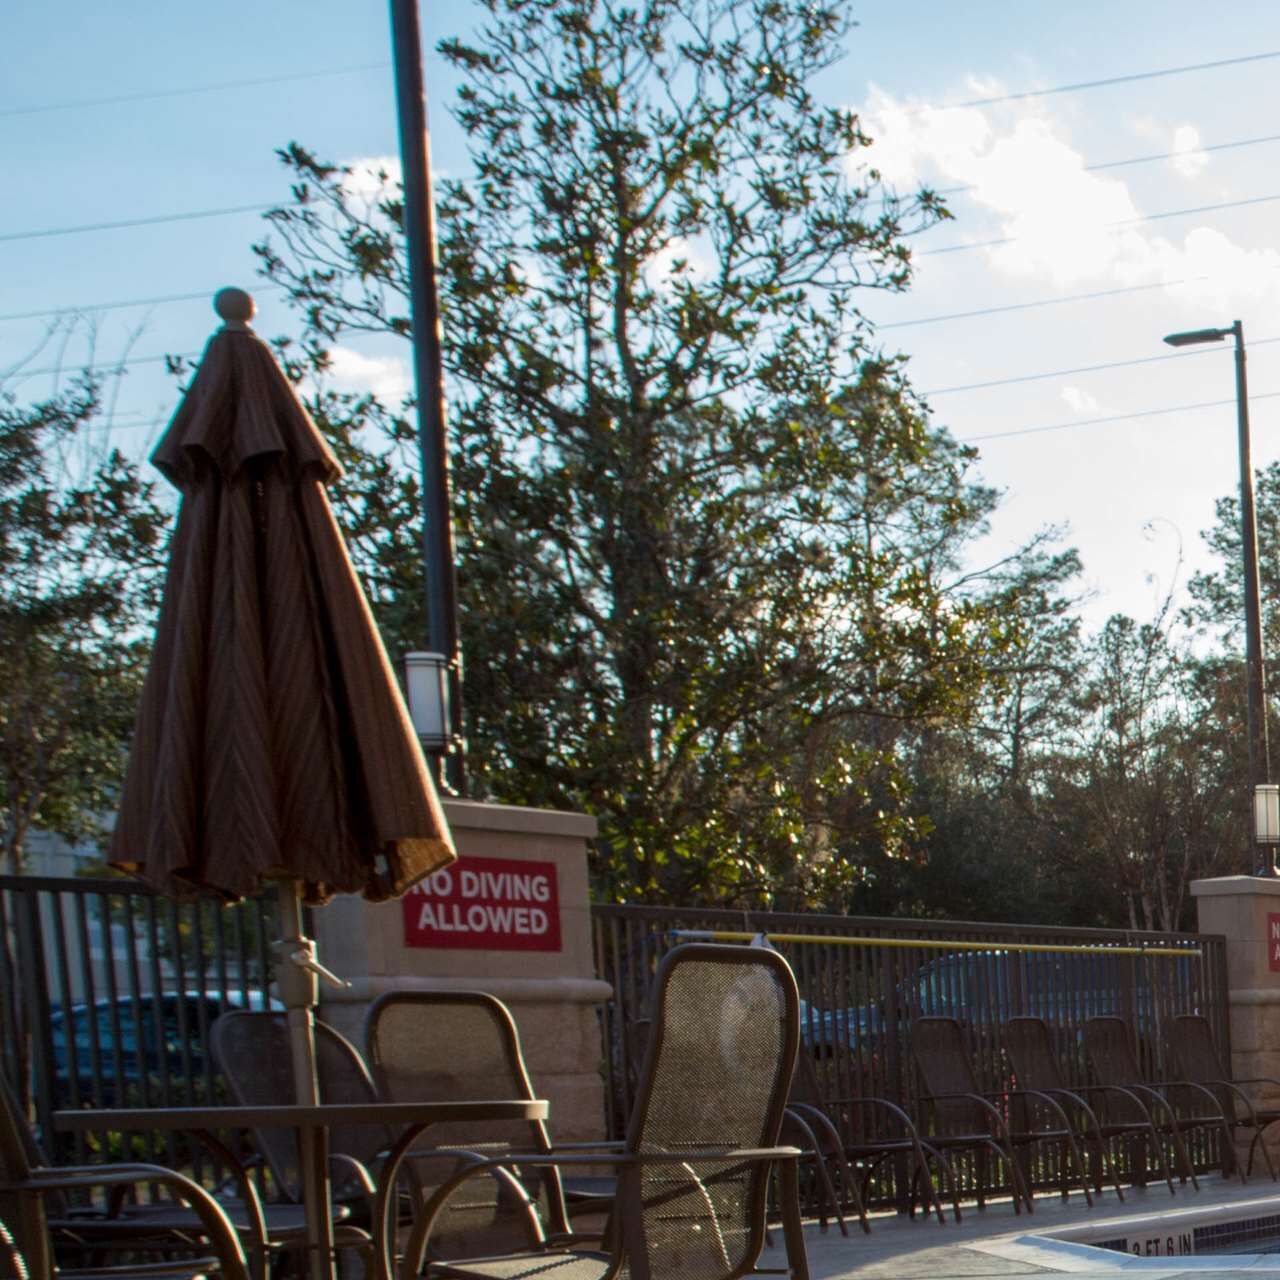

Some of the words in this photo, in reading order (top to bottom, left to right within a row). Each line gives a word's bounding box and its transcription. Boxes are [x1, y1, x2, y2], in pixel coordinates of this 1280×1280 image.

[461, 871, 550, 903] DIVING
[418, 903, 549, 935] ALLOWED
[1145, 1238, 1160, 1256] FT
[1166, 1236, 1175, 1256] 6
[1178, 1233, 1191, 1256] IN
